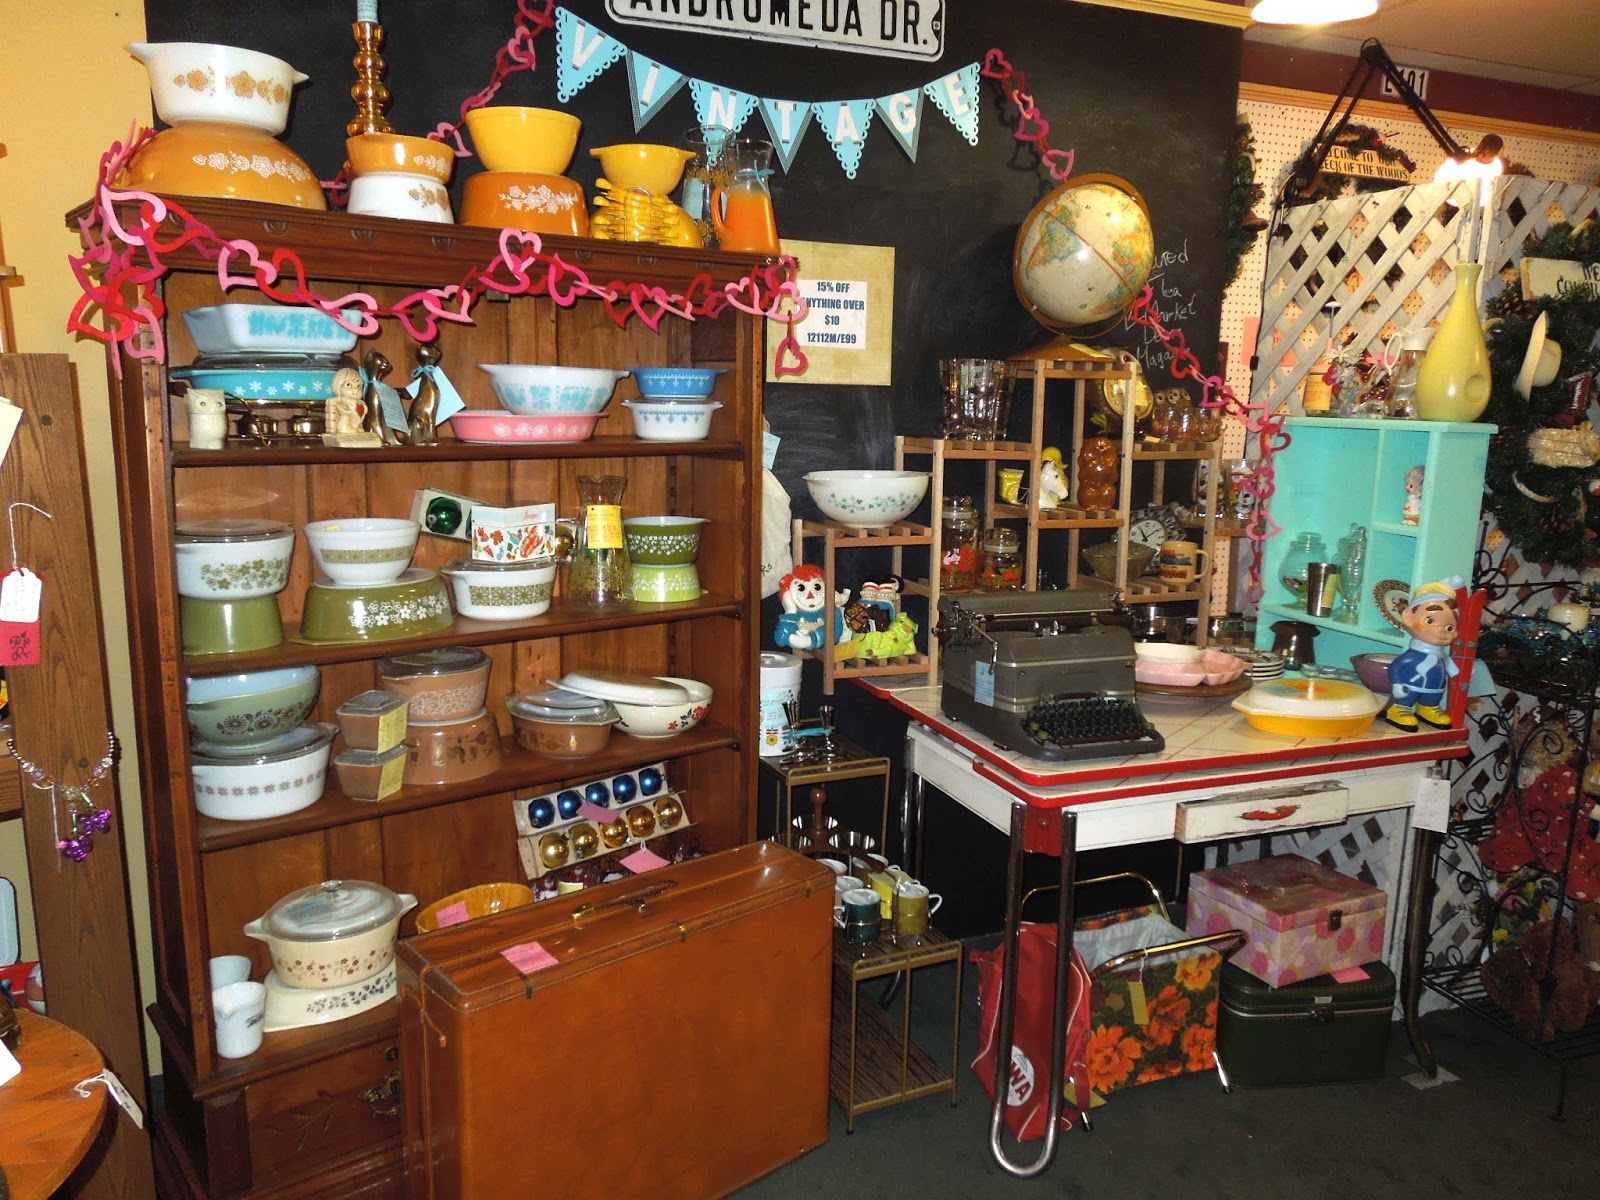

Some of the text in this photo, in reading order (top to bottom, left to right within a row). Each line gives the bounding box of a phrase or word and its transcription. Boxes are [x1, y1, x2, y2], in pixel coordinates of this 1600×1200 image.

[630, 0, 928, 45] ROMEDA DR.
[572, 19, 972, 146] VINTAGE
[1320, 159, 1342, 172] ECK
[1344, 162, 1354, 173] OF
[1357, 163, 1374, 175] THE
[817, 281, 850, 293] 15% OFF
[803, 297, 865, 311] NYTHING OVER
[824, 314, 840, 326] $10
[807, 332, 857, 344] 12112M/E99
[1009, 1061, 1031, 1101] WA
